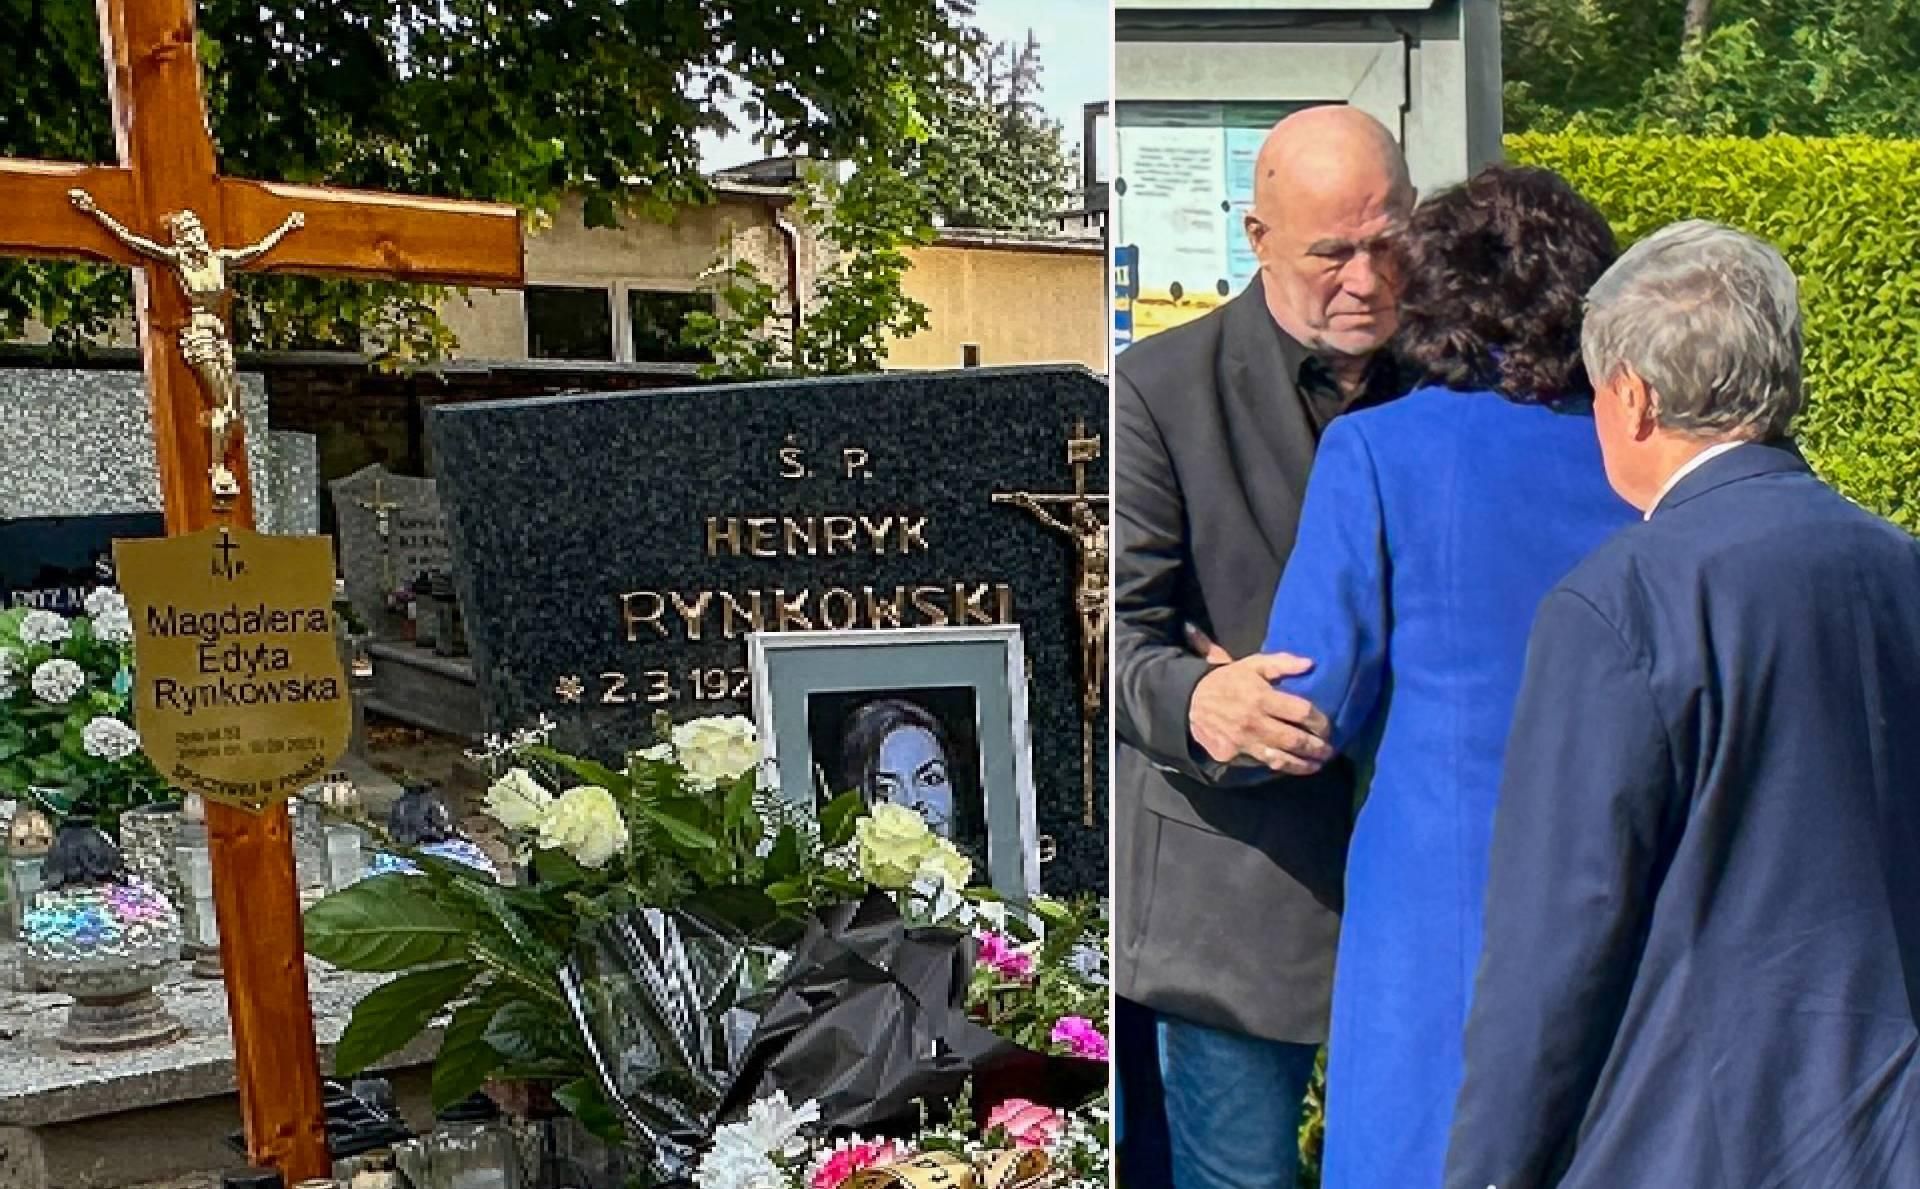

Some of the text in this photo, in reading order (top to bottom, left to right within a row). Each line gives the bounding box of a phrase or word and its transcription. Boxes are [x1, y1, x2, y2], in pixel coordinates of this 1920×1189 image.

[706, 515, 930, 558] HENRYK
[147, 602, 329, 642] Magdalena
[619, 582, 1010, 642] RYNKOWSKI
[198, 642, 290, 679] Edyta
[154, 674, 339, 716] Rynkowska
